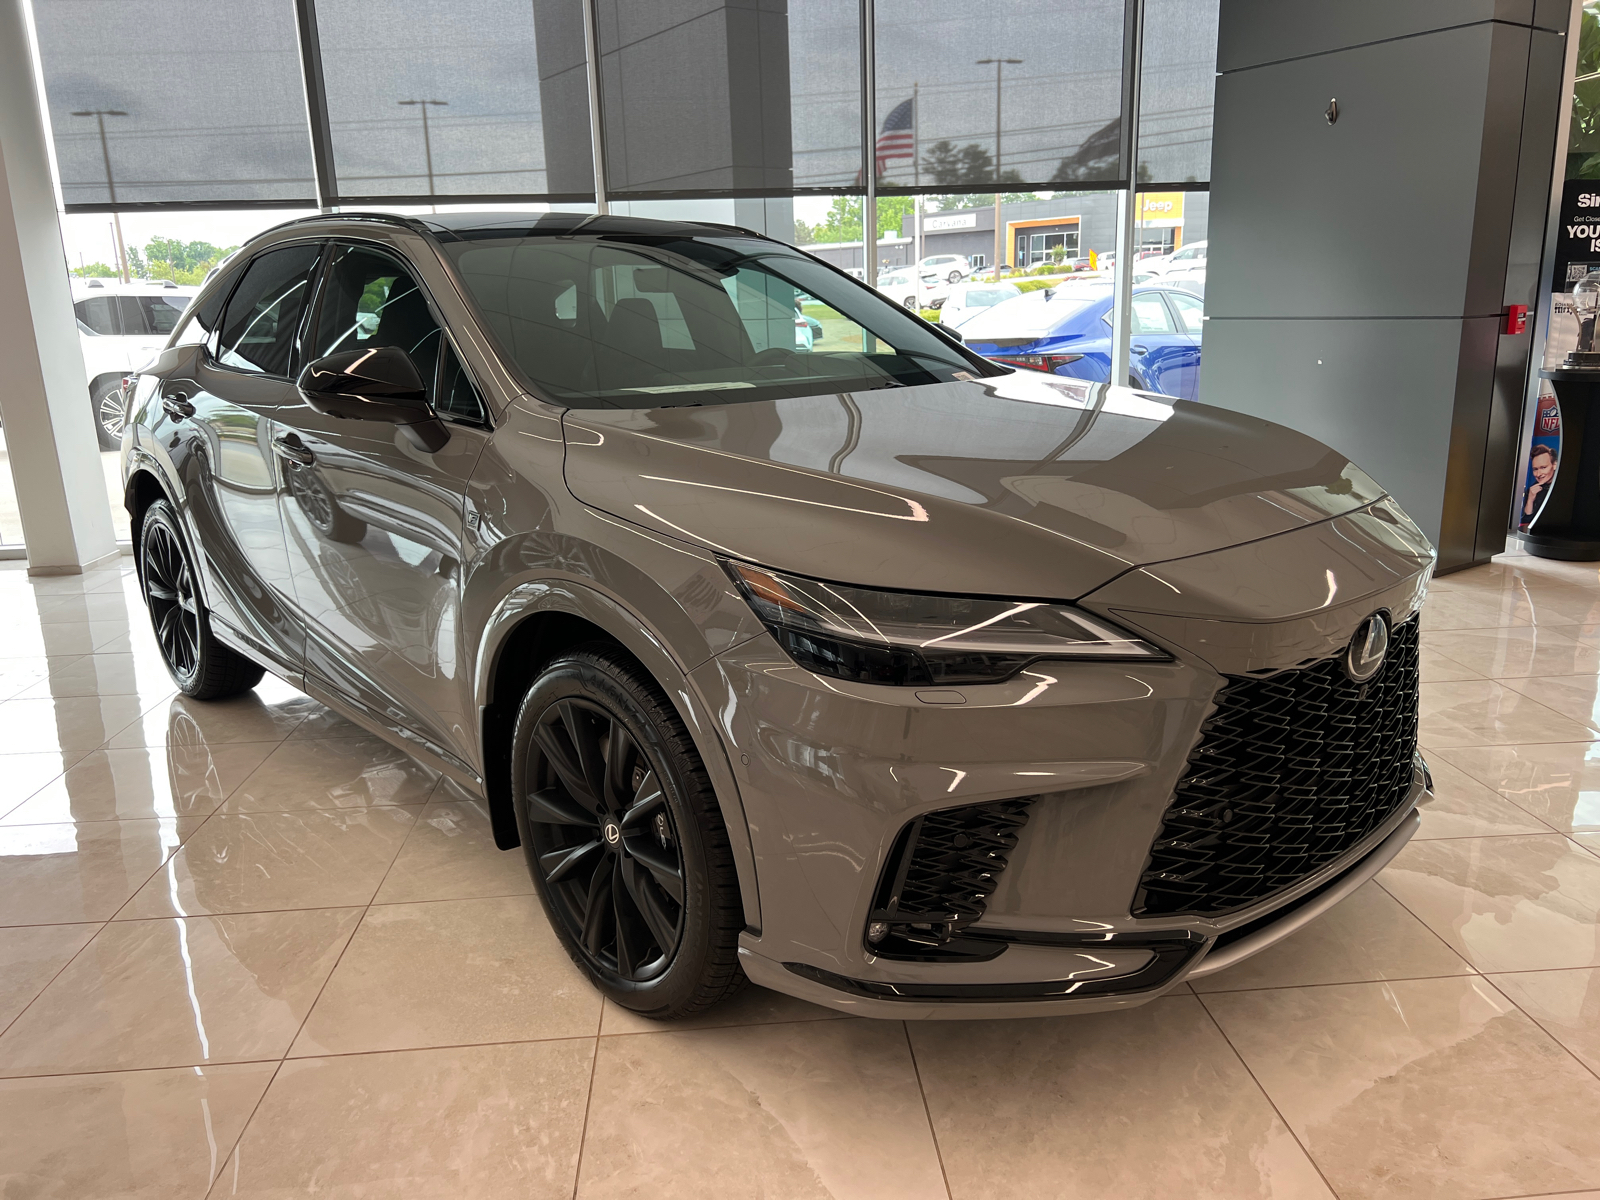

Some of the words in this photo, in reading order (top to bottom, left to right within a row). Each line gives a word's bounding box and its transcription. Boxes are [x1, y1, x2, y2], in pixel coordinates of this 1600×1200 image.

[1143, 199, 1173, 213] Jeep
[932, 219, 967, 229] Carvana
[1543, 417, 1560, 430] NFL
